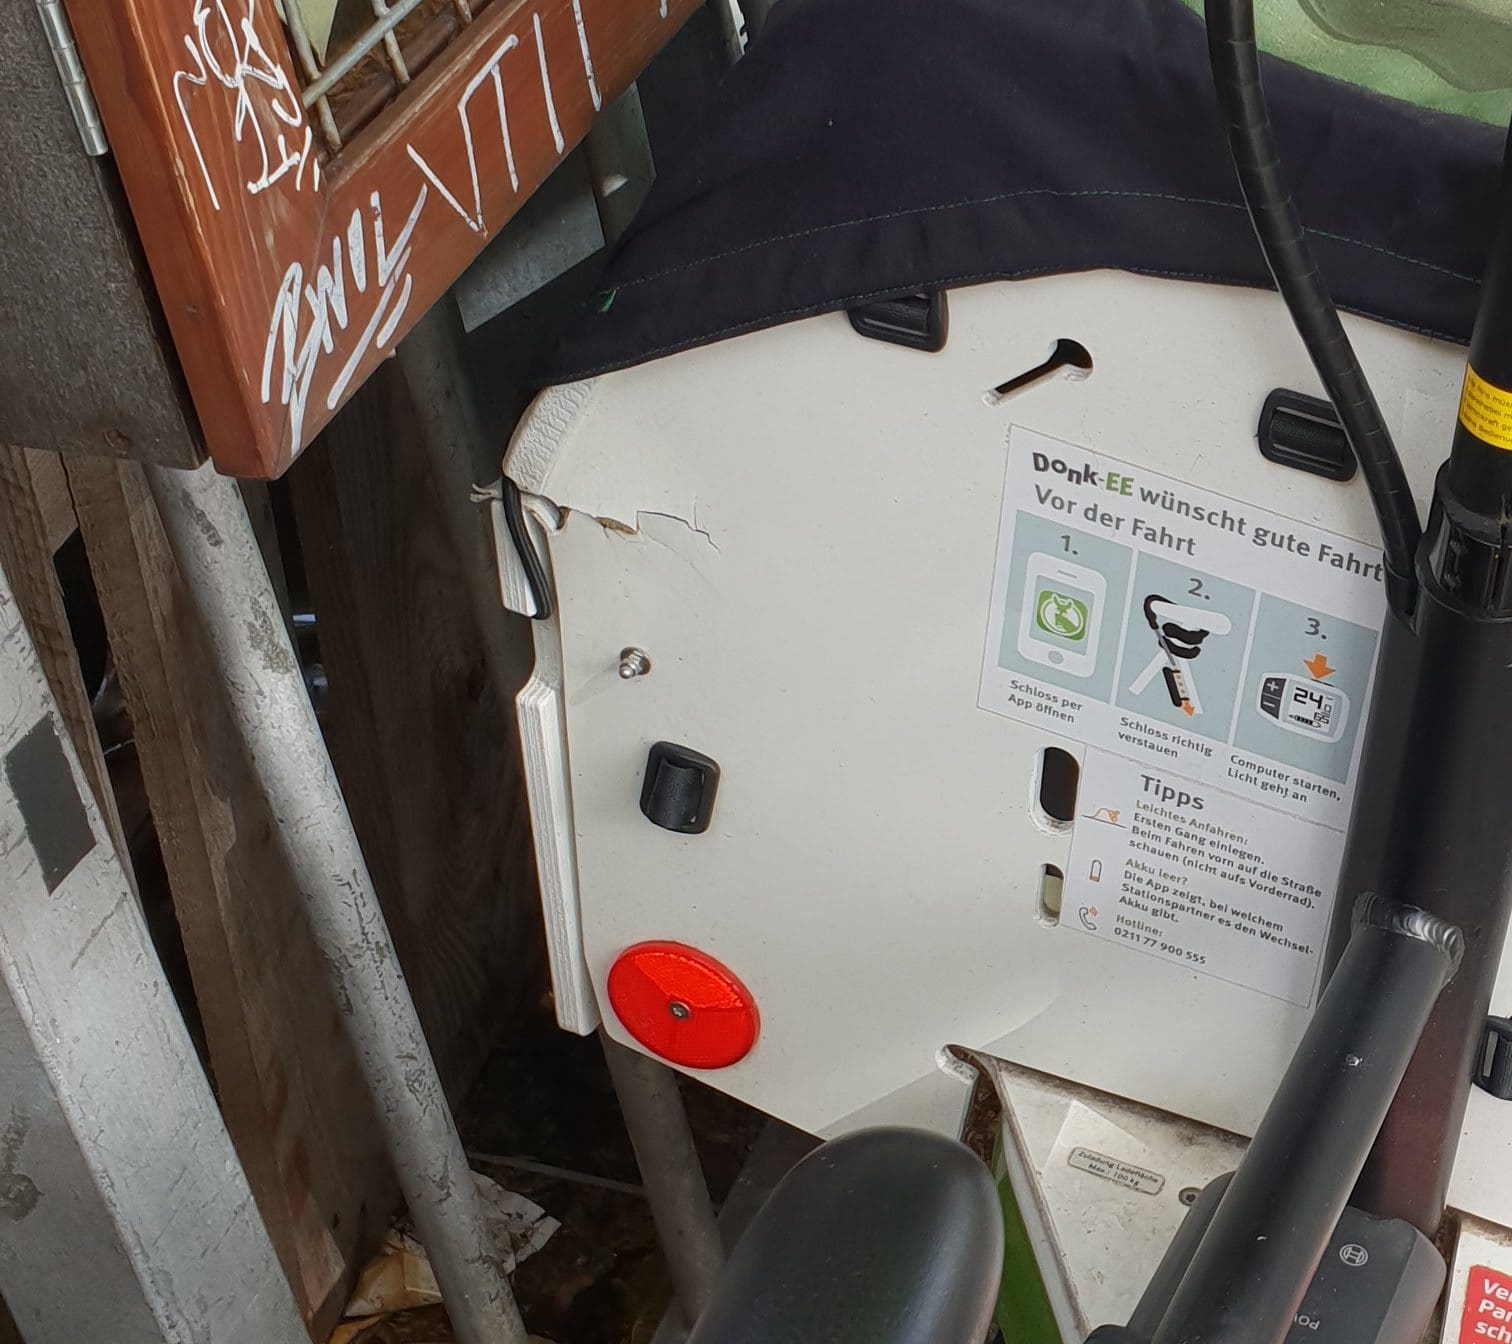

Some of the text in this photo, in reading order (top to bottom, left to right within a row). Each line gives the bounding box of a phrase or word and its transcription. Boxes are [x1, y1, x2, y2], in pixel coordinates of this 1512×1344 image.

[1032, 452, 1385, 582] Donk-EE wünscht gute Fahrt
[1034, 484, 1197, 556] Vor der Fahrt
[1060, 535, 1079, 556] 1.
[1188, 577, 1210, 600] 2.
[1304, 617, 1327, 640] 3.
[1008, 693, 1075, 724] App öffnen
[1010, 679, 1083, 712] Schloss per
[1118, 731, 1179, 758] verstauen
[1120, 716, 1214, 758] Schloss richtig
[1140, 774, 1204, 811] Tipps
[1227, 767, 1308, 803] Licht geht an
[1230, 754, 1341, 802] Computer starten,
[1136, 799, 1186, 824] Leichtes
[1134, 812, 1265, 865] Ersten Gang einlegen.
[1125, 858, 1189, 886] Akku leer?
[1129, 838, 1316, 909] schauen (nicht aufs Vorderrad).
[1131, 825, 1322, 898] Beim Fahren vorn auf die Straße
[1118, 895, 1179, 923] Akku gibt.
[1121, 882, 1314, 955] Stationspartner es den Wechsel-
[1124, 869, 1284, 933] Die App zeigt, bei welchem
[1116, 913, 1164, 938] Hotline:
[1114, 927, 1206, 965] 0211 77 900 555
